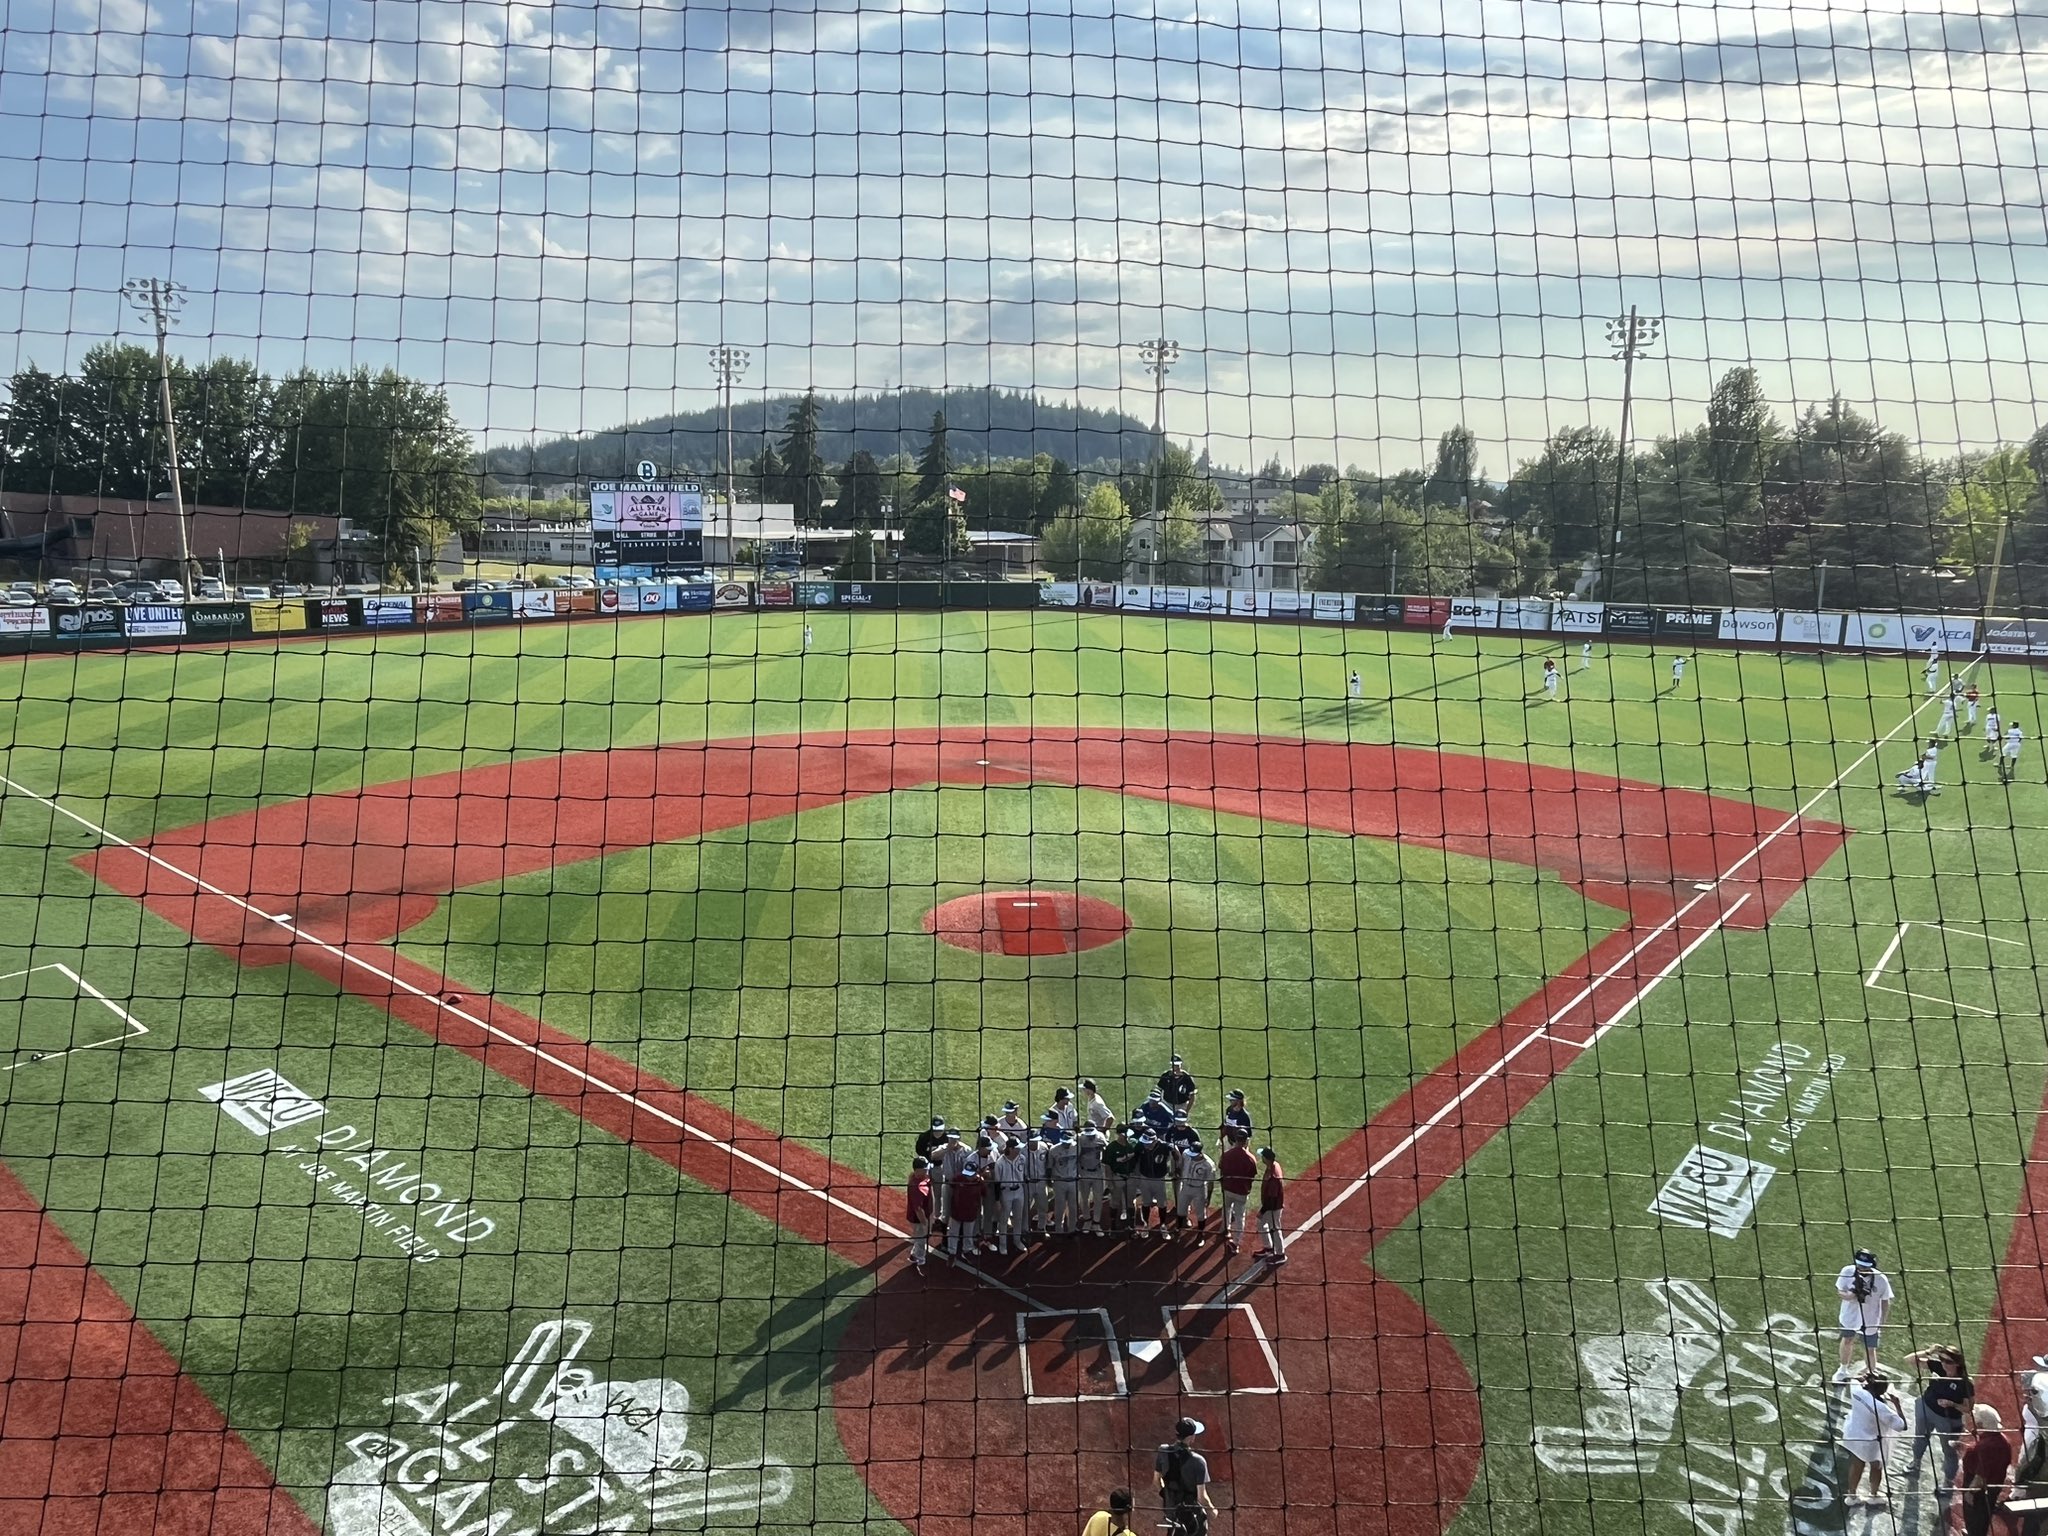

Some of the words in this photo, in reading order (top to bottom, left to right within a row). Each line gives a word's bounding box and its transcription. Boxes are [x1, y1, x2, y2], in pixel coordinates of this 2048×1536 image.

[593, 483, 616, 491] JOE
[620, 483, 664, 491] MARTIN
[629, 505, 644, 513] ALL
[322, 614, 348, 623] NEWS
[368, 601, 407, 609] FATENAL
[1707, 1043, 1811, 1142] DIAMOND
[1768, 1138, 1792, 1154] AT
[1793, 1078, 1830, 1115] MARTIN
[314, 1125, 495, 1242] DIAMOND
[299, 1161, 338, 1183] JOE
[327, 1180, 397, 1228] MARTIN
[383, 1224, 440, 1263] FIELD
